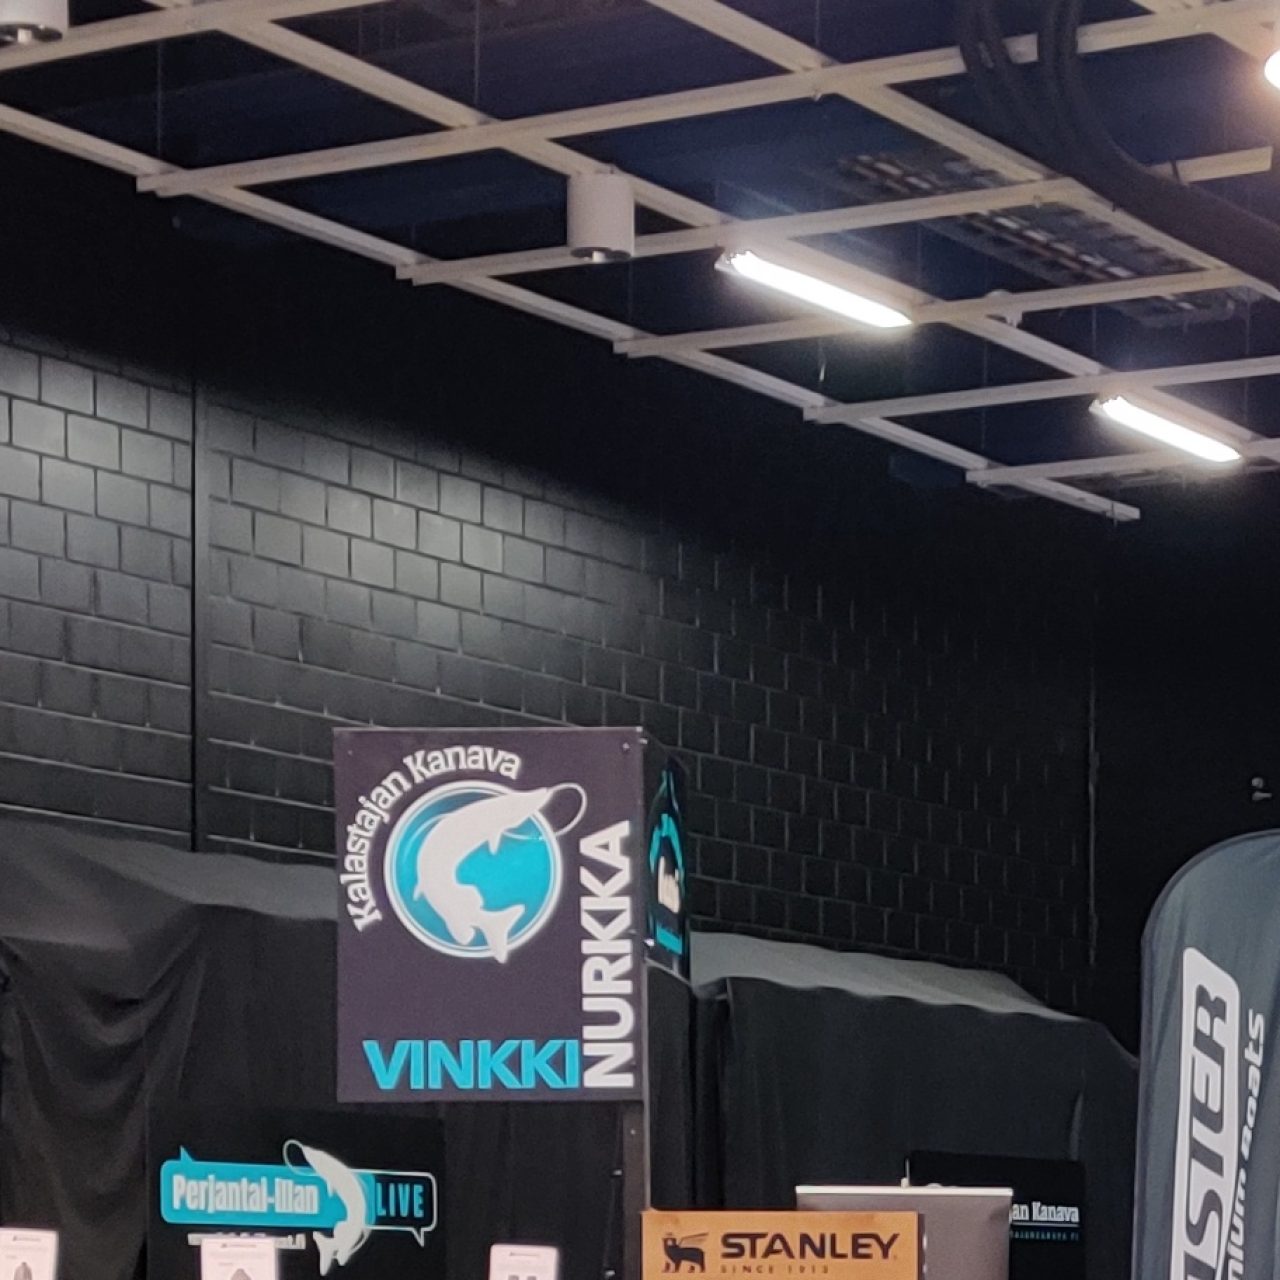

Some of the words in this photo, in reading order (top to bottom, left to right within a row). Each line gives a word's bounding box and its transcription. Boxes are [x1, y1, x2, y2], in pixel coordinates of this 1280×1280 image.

[340, 771, 411, 932] Kalastajan
[403, 745, 521, 780] Kanava
[580, 820, 635, 1088] NURKKA
[362, 1039, 580, 1090] VINKKI
[376, 1181, 425, 1218] LIVE
[721, 1232, 900, 1259] STANLEY
